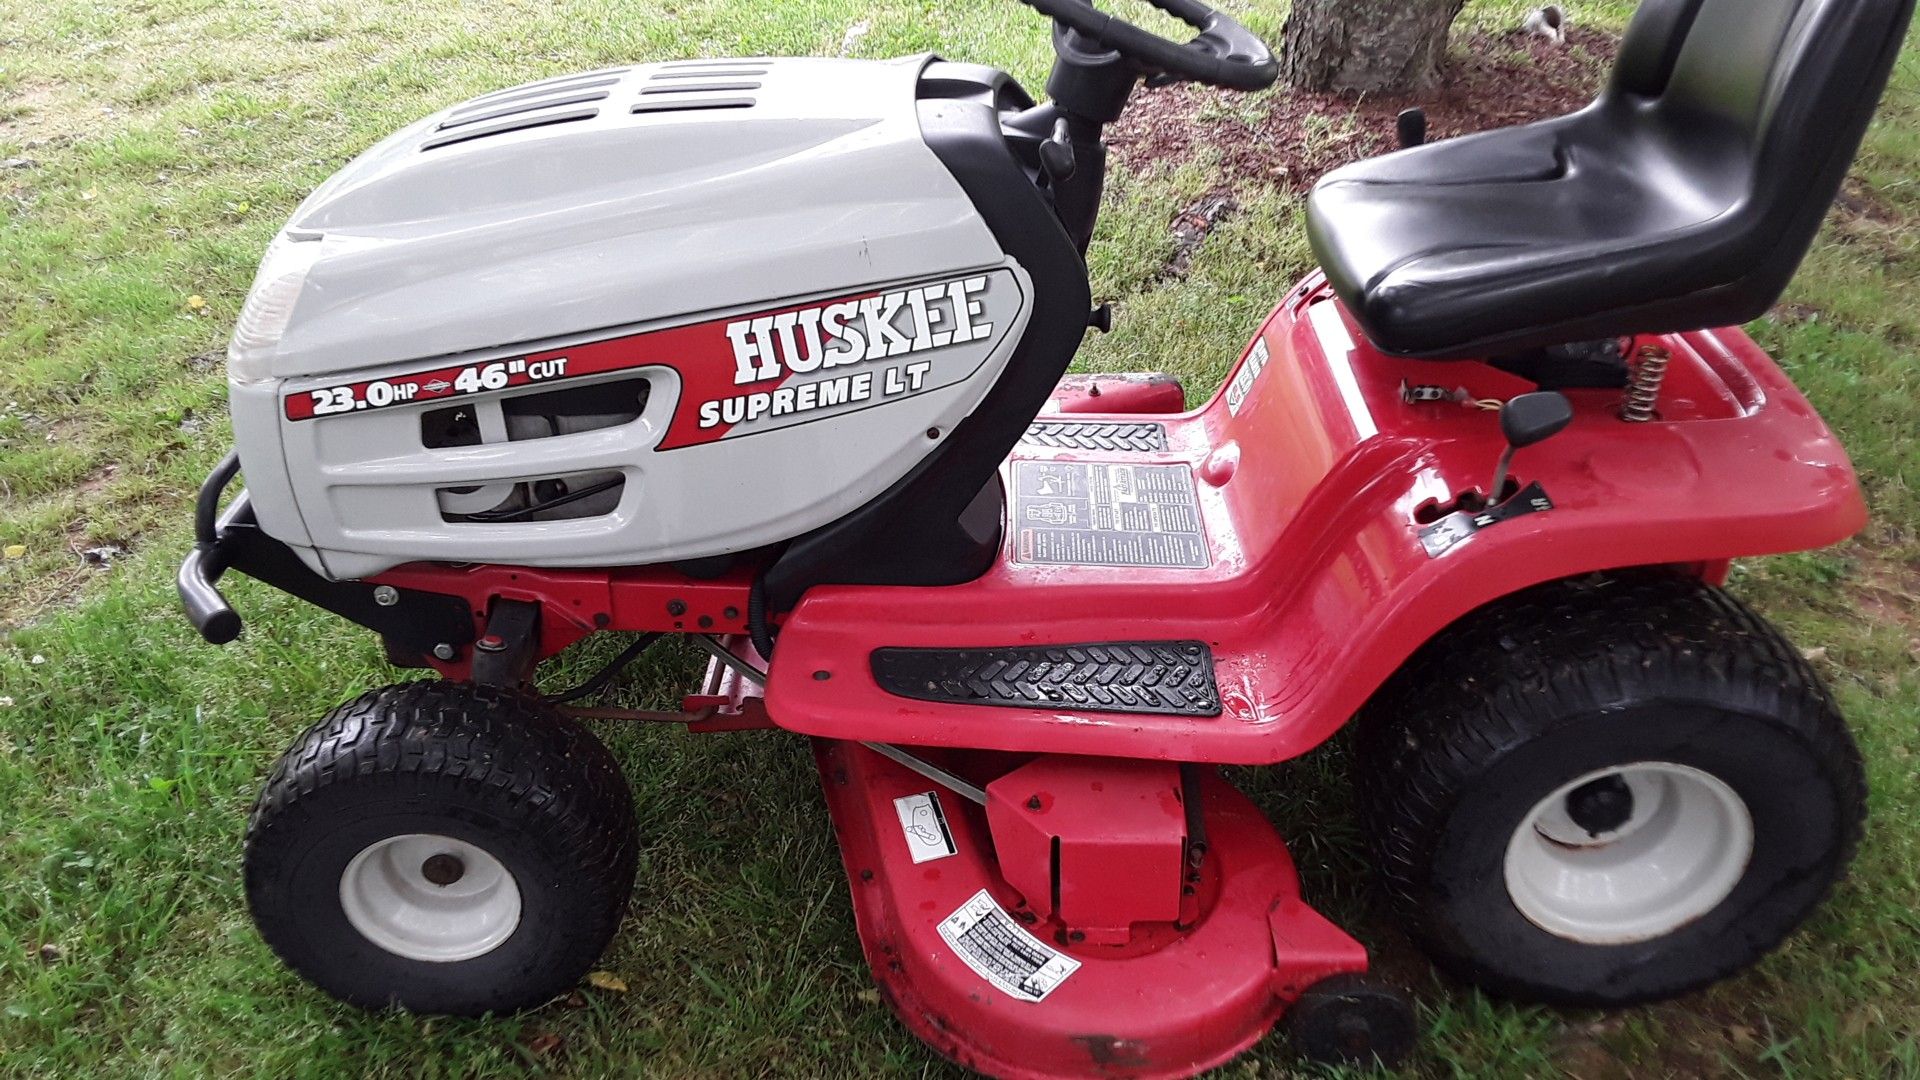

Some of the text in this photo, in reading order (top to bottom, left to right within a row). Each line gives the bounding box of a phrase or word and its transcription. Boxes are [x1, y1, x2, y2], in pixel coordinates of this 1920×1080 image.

[726, 276, 993, 384] HUSKEE
[528, 358, 568, 379] CUT
[699, 361, 931, 427] SUPREME LT
